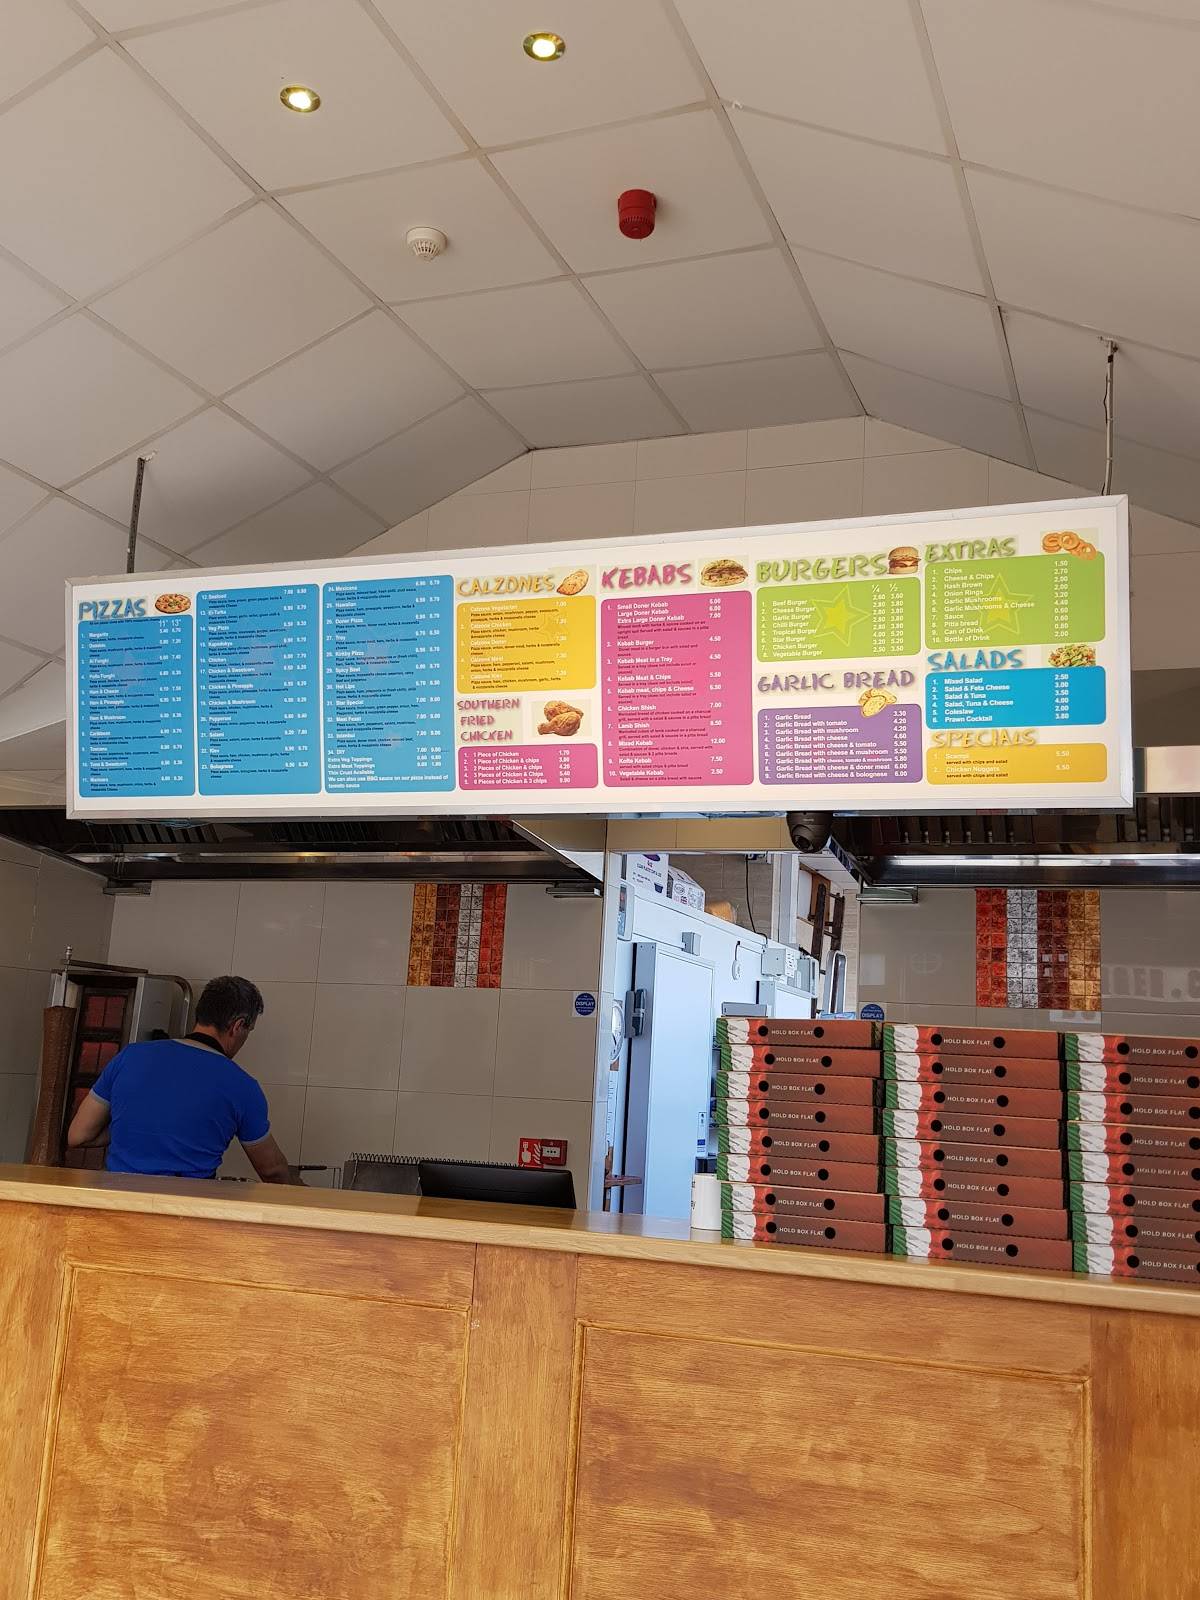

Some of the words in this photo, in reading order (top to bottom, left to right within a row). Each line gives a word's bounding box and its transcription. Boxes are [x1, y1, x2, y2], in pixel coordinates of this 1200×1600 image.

[925, 537, 1015, 562] EXTRAS
[602, 564, 692, 589] KEBABS
[757, 554, 887, 582] BURGERS
[457, 575, 554, 597] CALZONES
[964, 589, 983, 597] Rings
[79, 599, 146, 620] PIZZAS
[772, 650, 800, 658] Vegetable
[796, 642, 817, 650] Burger
[928, 649, 1023, 671] SALADS
[758, 673, 834, 692] GARLIC
[844, 670, 914, 689] BREAD
[457, 699, 520, 710] SOUTHERN
[460, 716, 494, 726] FRIED
[461, 730, 512, 742] CHICKEN
[932, 728, 1037, 748] SPECIALS
